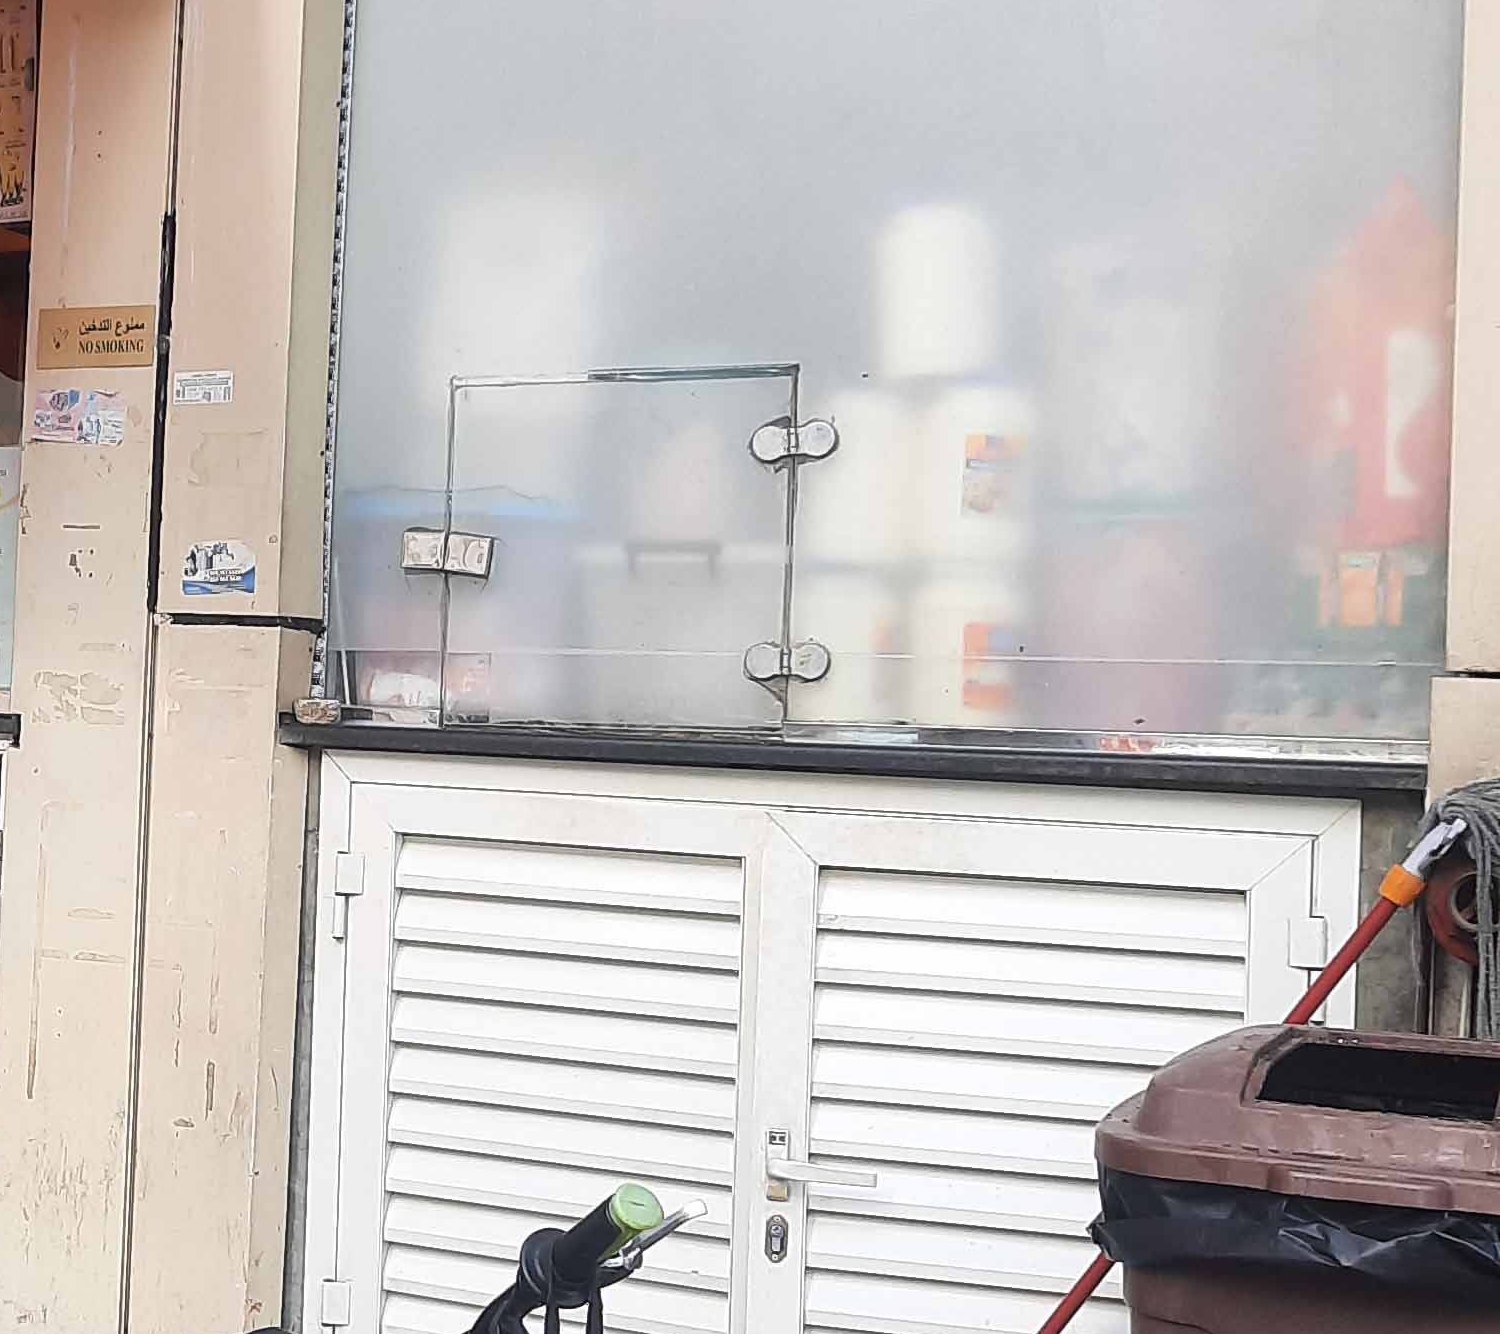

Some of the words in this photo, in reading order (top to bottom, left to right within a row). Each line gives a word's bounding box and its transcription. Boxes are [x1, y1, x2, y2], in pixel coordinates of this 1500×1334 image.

[79, 318, 112, 335] التدخين
[115, 316, 145, 337] ممنوع
[78, 340, 93, 354] NO
[94, 338, 145, 354] SMOKING
